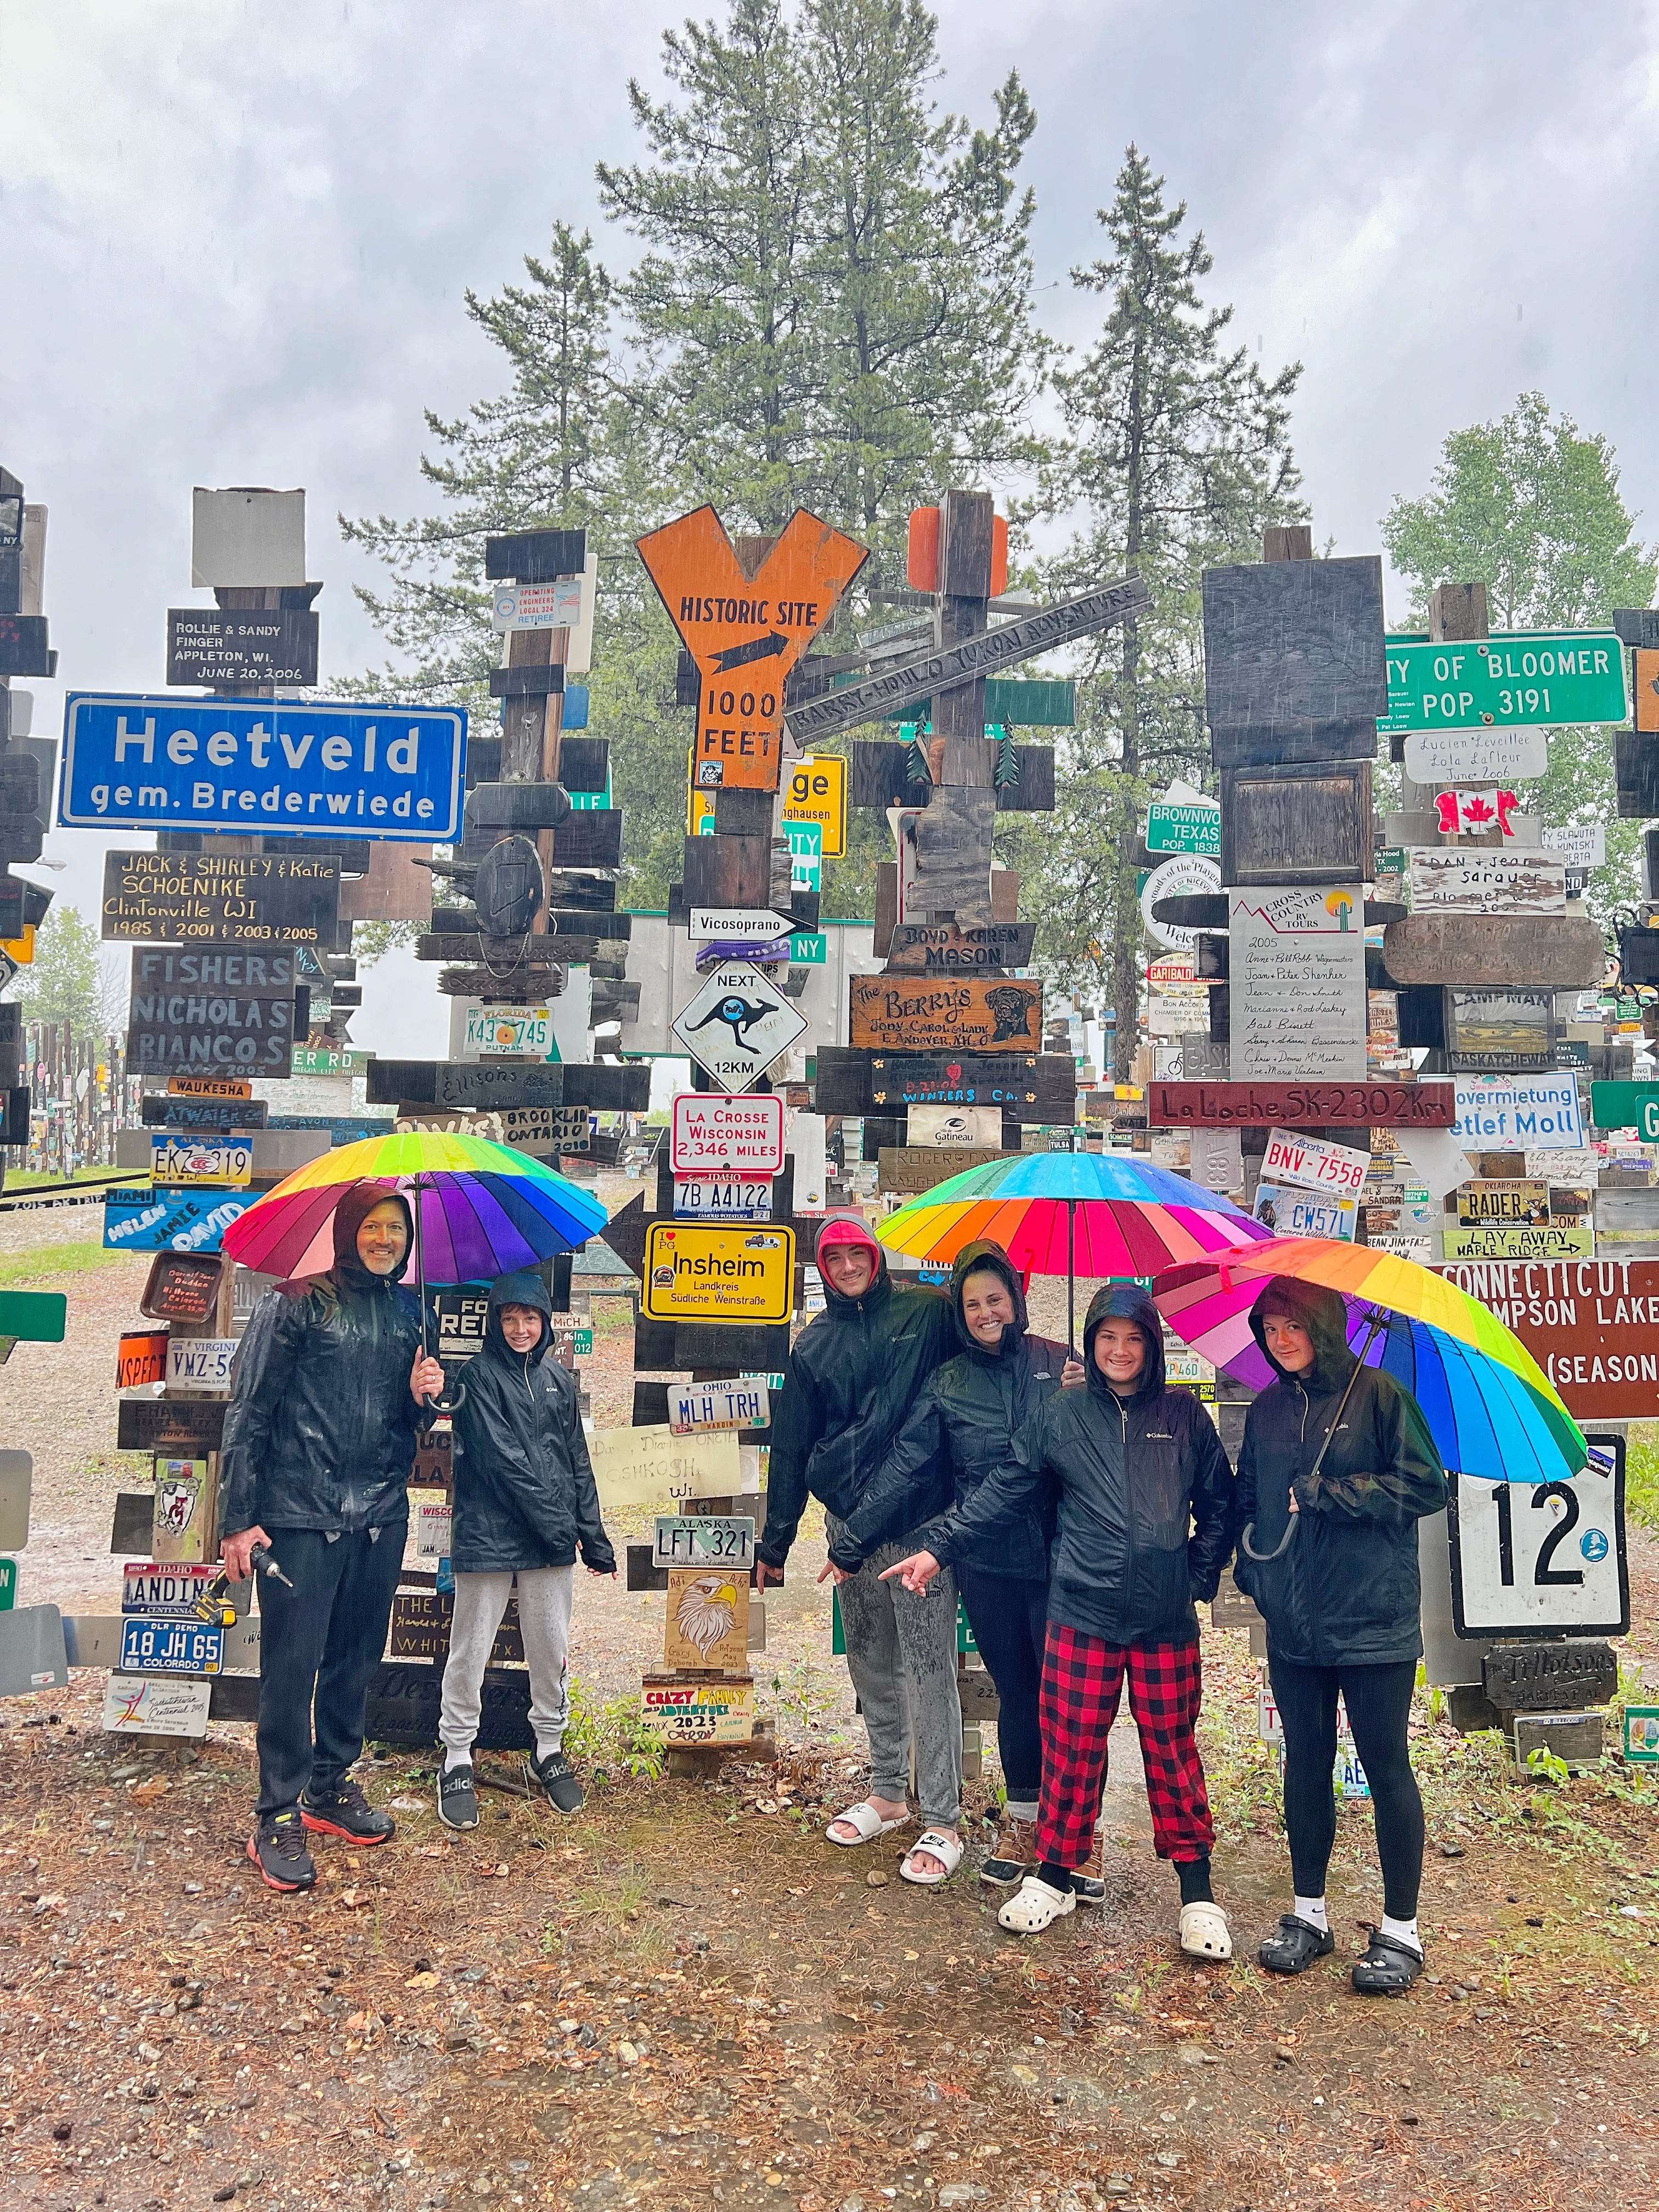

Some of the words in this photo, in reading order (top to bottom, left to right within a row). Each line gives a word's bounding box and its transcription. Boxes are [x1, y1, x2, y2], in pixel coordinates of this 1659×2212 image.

[520, 588, 555, 597] OPERATING
[520, 596, 554, 606] ENGINEERS
[518, 614, 554, 623] RETIREE
[680, 596, 769, 624] HISTORIC
[776, 601, 817, 627] SITE
[176, 623, 221, 634] ROLLIE
[239, 625, 281, 636] SANDY
[176, 636, 223, 647] FINGER
[175, 651, 249, 663] APPLETON,
[252, 653, 274, 663] WI.
[952, 630, 1022, 669] YUKON
[197, 667, 234, 679] JUNE
[1434, 656, 1465, 681] OF
[1487, 651, 1609, 679] BLOOMER
[708, 690, 775, 718] 1000
[1499, 689, 1551, 714] 3191
[114, 715, 420, 774] Heetveld
[705, 730, 770, 757] FEET
[1420, 737, 1468, 751] Lucien
[1431, 754, 1462, 766] Lola
[1471, 752, 1521, 765] Lafleur
[1482, 767, 1510, 779] 2006
[91, 783, 180, 813] gem.
[193, 781, 435, 817] Brederwiede
[1172, 824, 1219, 840] TEXAS
[1557, 828, 1596, 841] SLAWUTA
[1162, 839, 1186, 851] POP.
[1193, 842, 1220, 853] 1838
[122, 856, 171, 873] JACK
[197, 858, 272, 876] SHIRLEY
[290, 860, 335, 878] Katie
[1177, 864, 1191, 873] the
[122, 875, 246, 898] SCHOENIKE
[104, 897, 211, 918] Clintonville
[224, 900, 256, 919] WI
[1265, 890, 1302, 913] CROSS
[1271, 891, 1324, 923] COUNTRY
[114, 922, 153, 936] 1985
[176, 923, 215, 938] 2001
[234, 925, 271, 939] 2003
[283, 927, 318, 940] 2005
[701, 917, 781, 933] Vicosoprano
[905, 927, 949, 945] BOYD
[1248, 936, 1279, 948] 2005
[926, 947, 1001, 966] MASON
[142, 954, 291, 986] FISHERS
[1150, 967, 1194, 981] GARIBALDI
[1245, 968, 1269, 980] Joan
[1277, 967, 1300, 980] Peter
[717, 975, 757, 987] NEXT
[857, 984, 881, 1003] The
[133, 995, 289, 1029] NICHOLAS
[484, 1008, 532, 1019] FLORIDA
[468, 1019, 495, 1045] K43
[139, 1033, 285, 1065] BIANCOS
[486, 1043, 523, 1052] PUTNAM
[328, 1052, 357, 1068] RD.
[1452, 1053, 1557, 1069] SASKATCHEWAN
[227, 1065, 267, 1077] 2005
[714, 1062, 754, 1074] 12KM
[176, 1081, 245, 1096] WAUKESHA
[902, 1089, 975, 1102] WINTERS
[1108, 1103, 1142, 1116] Newton
[1161, 1089, 1195, 1120] La
[1515, 1110, 1574, 1136] Moll
[507, 1125, 583, 1142] ONTARIO
[935, 1132, 974, 1143] Gatineau
[678, 1142, 729, 1157] 2,346
[1050, 1140, 1070, 1149] TULSA
[1292, 1138, 1325, 1154] Alberta
[707, 1173, 741, 1182] IDAHO
[1485, 1182, 1521, 1190] OKLAHOMA
[106, 1189, 154, 1203] MIAMI
[680, 1183, 702, 1207] 7B
[711, 1183, 767, 1208] A4122
[1284, 1190, 1331, 1204] FLORIDA
[1368, 1196, 1401, 1205] SANDRA
[1469, 1192, 1522, 1217] RADER
[108, 1203, 167, 1243] HELEN
[155, 1201, 201, 1245] JAMIE
[172, 1202, 245, 1251] DAVID
[1293, 1204, 1348, 1235] CW57L
[1471, 1231, 1507, 1245] LAY
[1521, 1231, 1567, 1245] AWAY
[658, 1242, 675, 1250] PG
[1457, 1245, 1497, 1256] MAPLE
[1509, 1245, 1550, 1256] RIDGE
[674, 1251, 764, 1278] Insheim
[693, 1280, 739, 1291] Landkreis
[1442, 1261, 1631, 1300] CONNECTICUT
[670, 1293, 709, 1304] Südliche
[714, 1294, 766, 1306] Weinstraße
[195, 1342, 236, 1352] VIRGINI
[703, 1381, 731, 1391] OHIO
[1200, 1385, 1215, 1393] 2570
[679, 1396, 714, 1425] MLH
[725, 1391, 760, 1419] TRH
[707, 1420, 734, 1430] HARDIN
[606, 1458, 696, 1482] OSHKOSH
[679, 1519, 731, 1529] ALASKA
[1492, 1482, 1584, 1586] 12
[422, 1545, 435, 1553] JAN
[658, 1528, 697, 1556] LFT
[711, 1528, 747, 1557] 321
[157, 1565, 192, 1575] IDAHO
[134, 1577, 215, 1603] ANDIN
[397, 1597, 432, 1614] THE
[151, 1622, 169, 1630] DLR
[175, 1624, 198, 1633] DEMO
[127, 1630, 155, 1656] 18
[161, 1632, 187, 1658] JH
[193, 1634, 219, 1661] 65
[668, 1646, 690, 1658] Gary
[143, 1657, 200, 1670] COLORADO
[667, 1658, 698, 1668] Deborah
[646, 1690, 696, 1705] CRAZY
[697, 1690, 747, 1706] FAMILY
